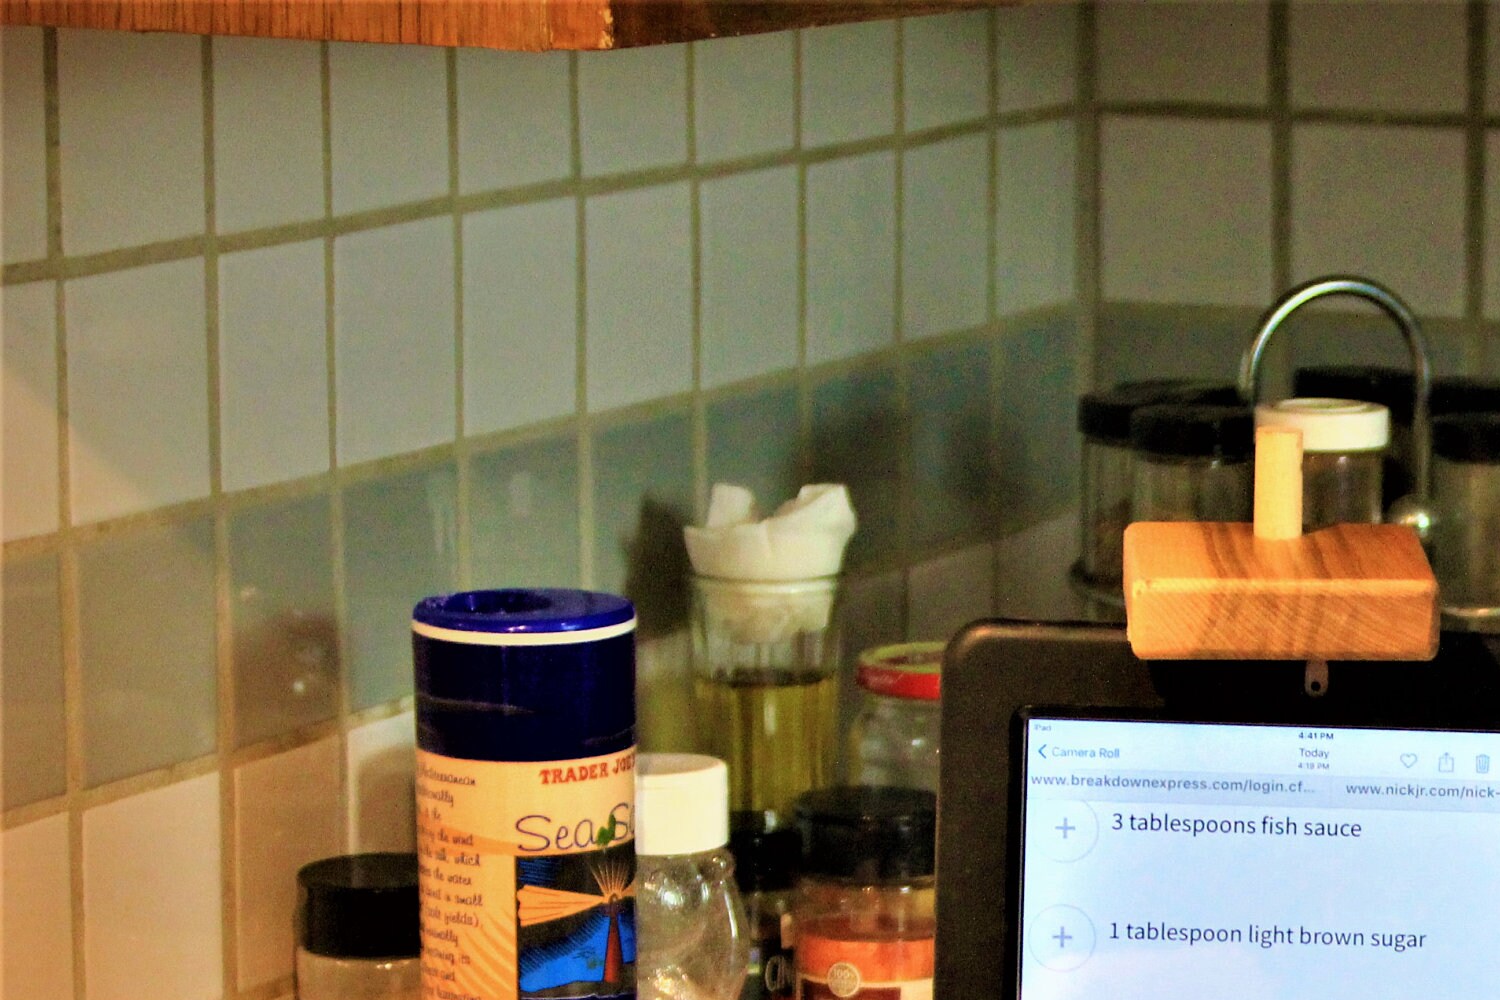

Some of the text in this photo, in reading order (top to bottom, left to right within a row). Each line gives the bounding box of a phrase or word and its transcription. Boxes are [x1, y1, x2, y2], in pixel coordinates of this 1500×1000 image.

[1319, 732, 1334, 740] PM
[1051, 746, 1120, 759] Camera Roll
[1298, 747, 1330, 760] Today
[539, 761, 609, 785] TRADER
[515, 814, 597, 852] Sea
[1112, 813, 1361, 837] 3 tablespoons fish sauce
[1110, 922, 1426, 952] 1 tablespoon light brown sugar
